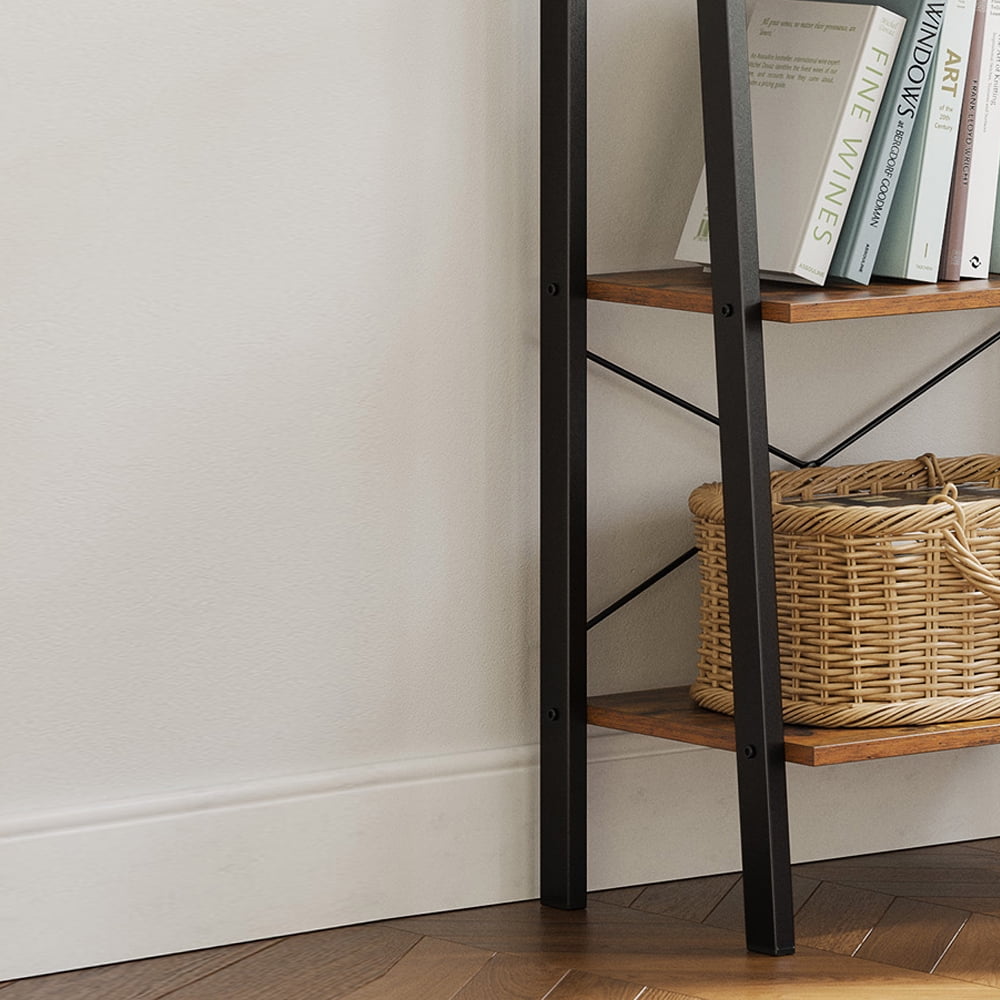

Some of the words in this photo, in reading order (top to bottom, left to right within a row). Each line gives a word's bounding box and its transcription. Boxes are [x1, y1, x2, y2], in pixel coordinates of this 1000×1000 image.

[850, 46, 890, 123] FINE
[896, 2, 946, 119] WINDOWS
[941, 48, 962, 98] ART
[968, 80, 978, 111] FRANK
[934, 122, 953, 133] Century
[884, 129, 905, 178] BERGDORF
[813, 138, 863, 245] WINES
[870, 178, 891, 228] GOODMAN
